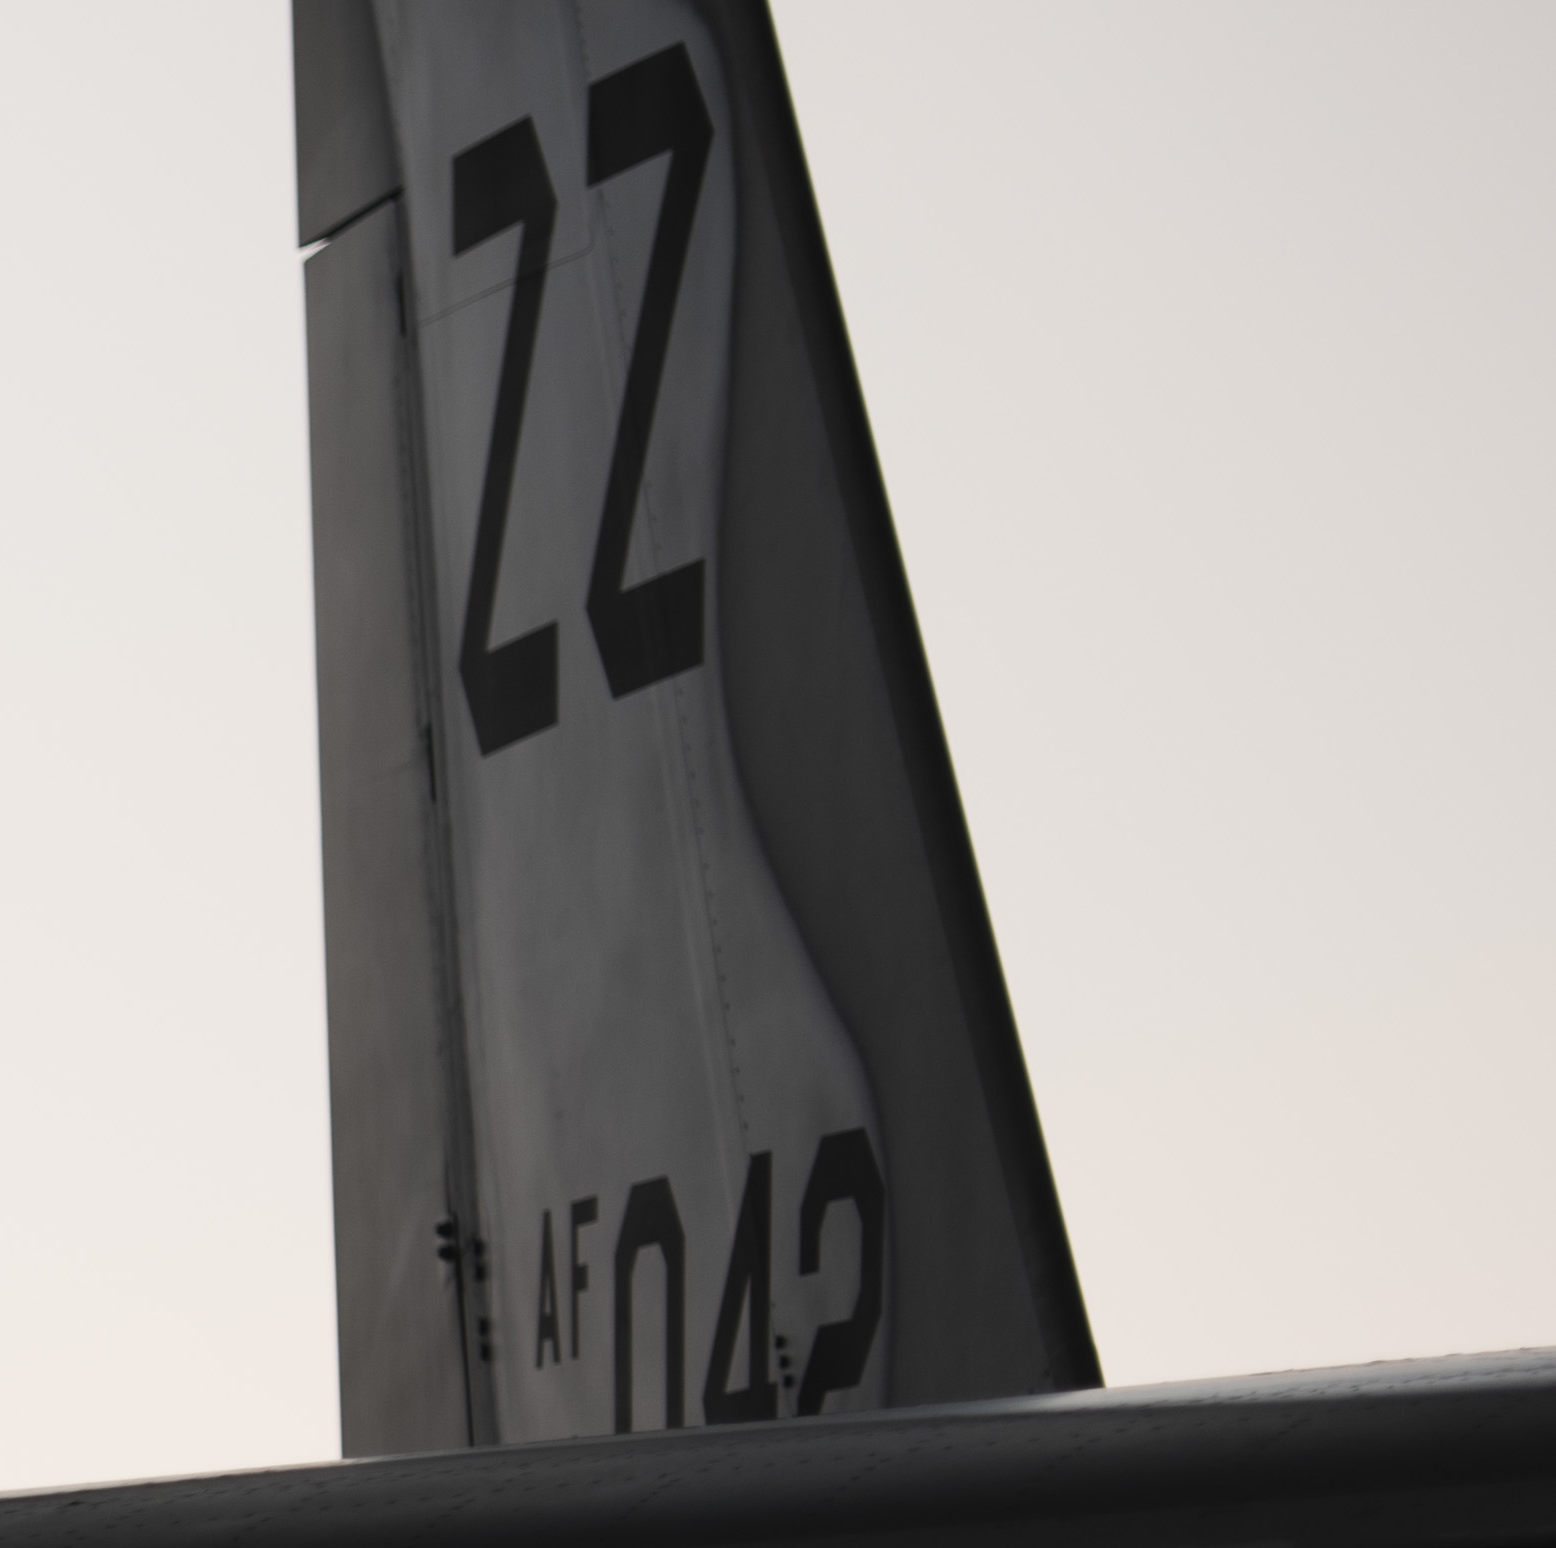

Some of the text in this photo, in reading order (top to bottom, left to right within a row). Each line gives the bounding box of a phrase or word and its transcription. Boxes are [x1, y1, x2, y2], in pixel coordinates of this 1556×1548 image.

[451, 40, 715, 758] ZZ
[535, 1127, 885, 1434] AF 042
